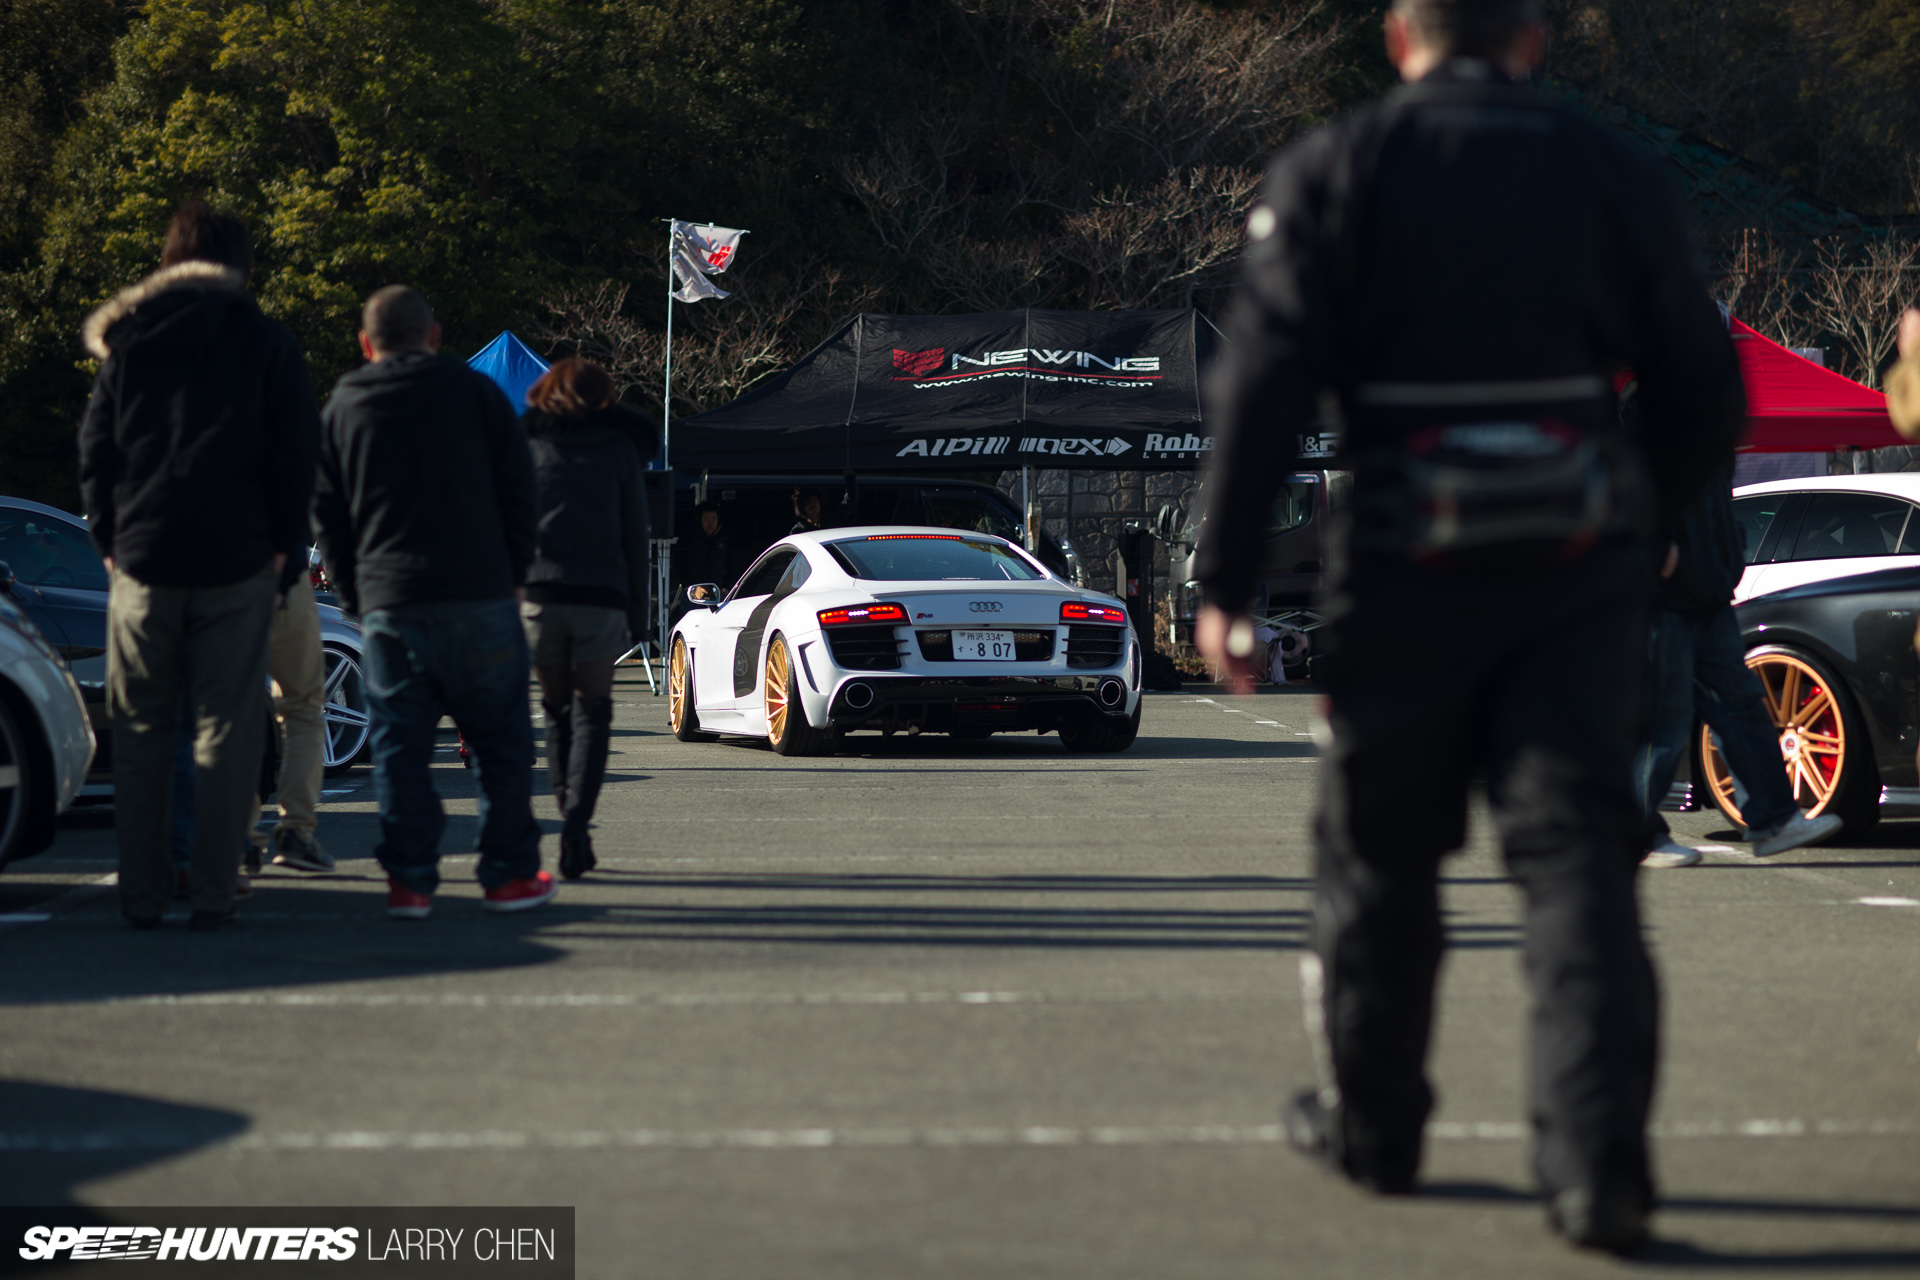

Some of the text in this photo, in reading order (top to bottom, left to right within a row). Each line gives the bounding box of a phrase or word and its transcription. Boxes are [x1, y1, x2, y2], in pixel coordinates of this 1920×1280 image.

[952, 348, 1160, 371] NEWING
[913, 371, 1154, 388] www.newing-inc.com
[1144, 433, 1218, 452] Robs
[1142, 451, 1216, 459] Leat
[985, 632, 1001, 642] 334
